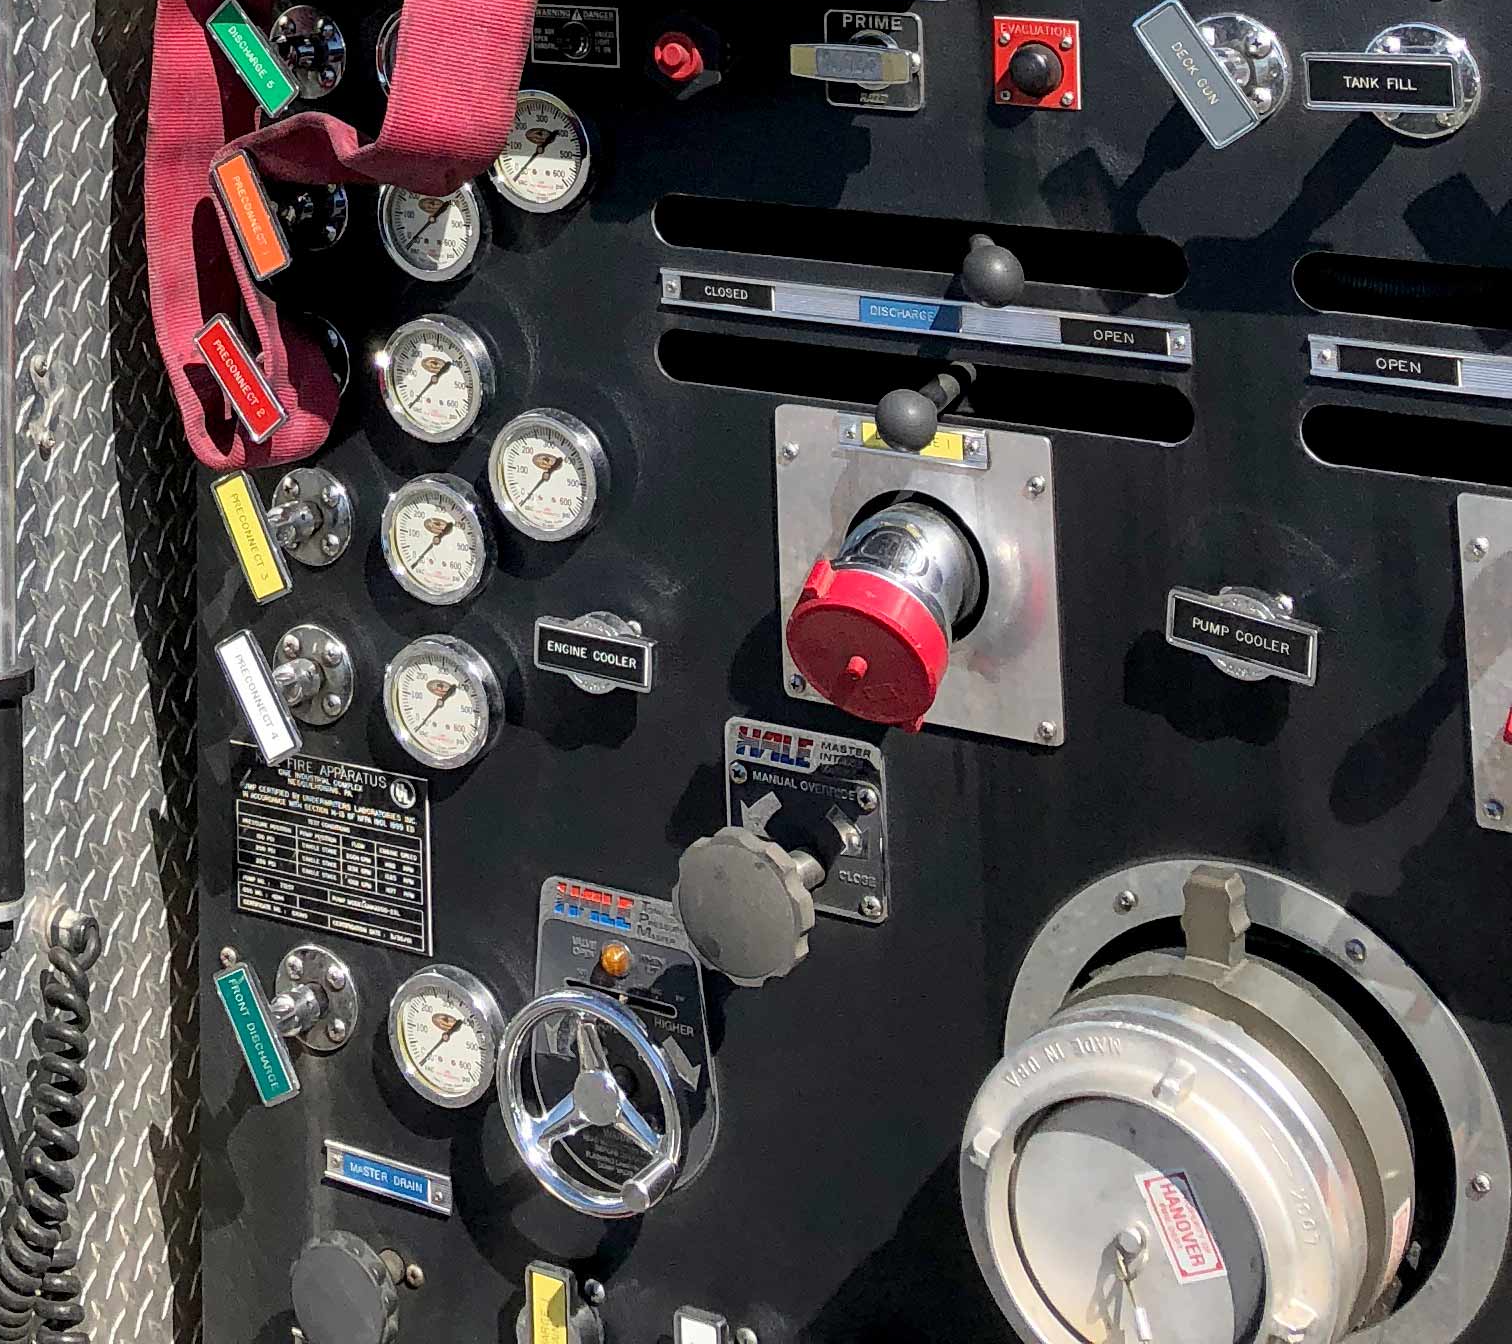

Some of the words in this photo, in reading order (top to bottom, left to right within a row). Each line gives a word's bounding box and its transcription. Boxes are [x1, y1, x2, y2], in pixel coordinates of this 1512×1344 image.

[842, 14, 903, 31] PRIME
[1000, 23, 1072, 37] EVACUATION
[227, 25, 267, 80] DISCHARGE
[1171, 41, 1200, 77] DECK
[1196, 78, 1221, 105] GUN
[1343, 75, 1379, 89] TANK
[1386, 78, 1418, 91] FILL
[536, 115, 547, 123] 300
[232, 175, 268, 245] PRECONNECT
[452, 220, 462, 228] 500
[704, 285, 748, 300] CLOSED
[869, 305, 936, 322] DISCHARGE
[1093, 329, 1135, 344] OPEN
[1375, 357, 1422, 374] OPEN
[212, 338, 259, 406] PRECONNECT
[255, 406, 265, 418] 2
[447, 400, 458, 408] 600
[560, 498, 571, 506] 600
[231, 492, 265, 573] PRECONNECT
[450, 562, 461, 570] 600
[1192, 616, 1230, 637] PUMP
[1235, 630, 1290, 655] COOLER
[547, 640, 588, 659] ENGINE
[592, 650, 637, 669] COOLER
[234, 654, 275, 728] PRECONNECT
[735, 725, 813, 768] HALE
[819, 742, 872, 758] MASTER
[287, 756, 313, 773] FIRE
[319, 761, 387, 789] APPARATUS
[752, 771, 798, 789] MANUAL
[838, 870, 878, 888] CLOSE
[228, 978, 250, 1017] FRONT
[246, 1022, 279, 1090] DISCHARGE
[653, 1017, 694, 1037] HIGHER
[1044, 1042, 1065, 1063] IN
[350, 1162, 388, 1183] MASTER
[393, 1176, 423, 1193] DRAIN
[1160, 1183, 1206, 1267] HANOVER
